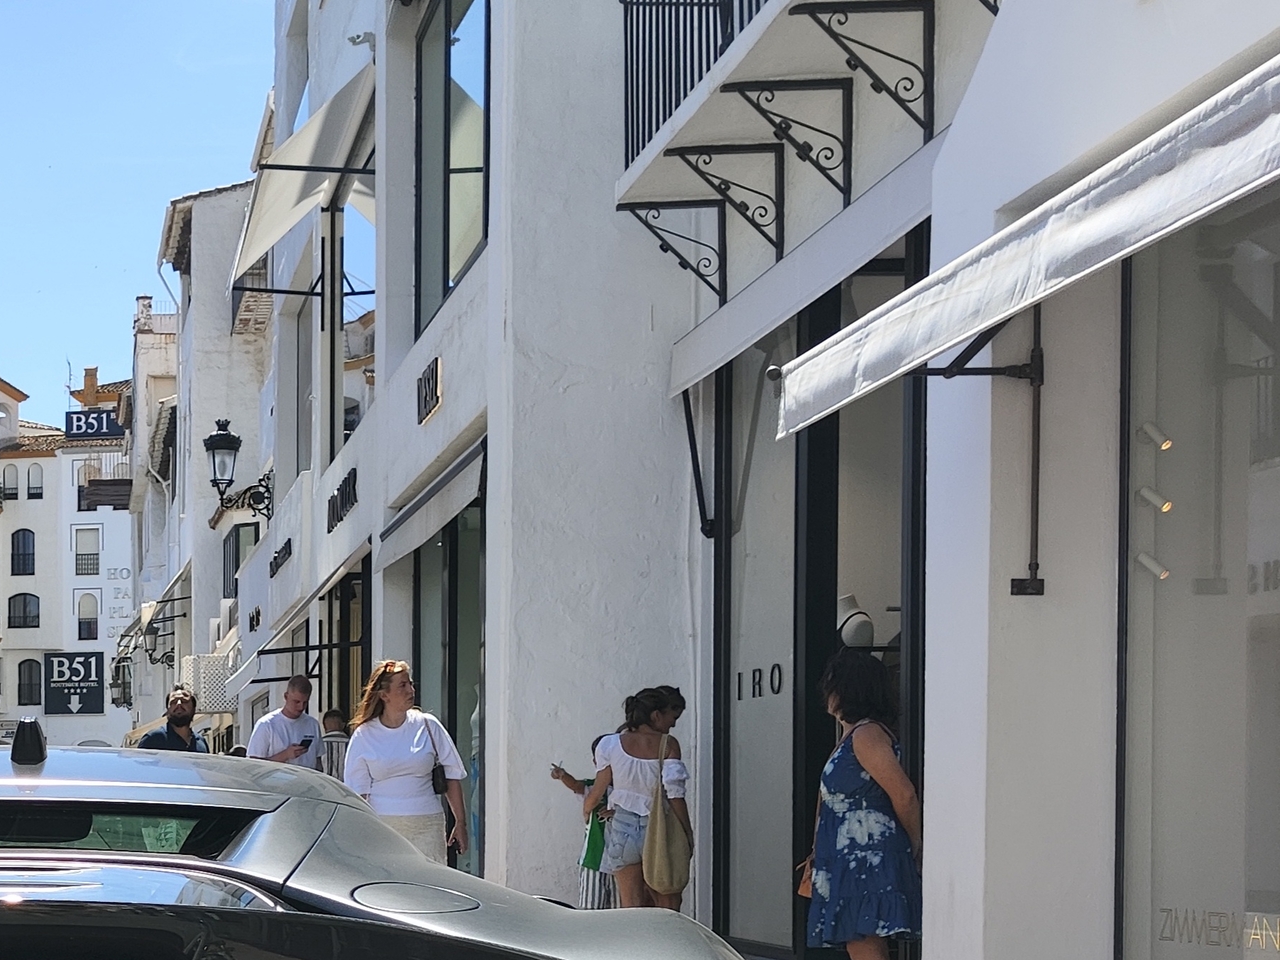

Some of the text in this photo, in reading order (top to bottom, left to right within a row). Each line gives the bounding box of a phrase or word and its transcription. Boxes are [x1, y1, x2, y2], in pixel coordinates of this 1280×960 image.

[70, 413, 109, 433] B51
[50, 656, 98, 681] B51
[737, 663, 782, 701] IRO
